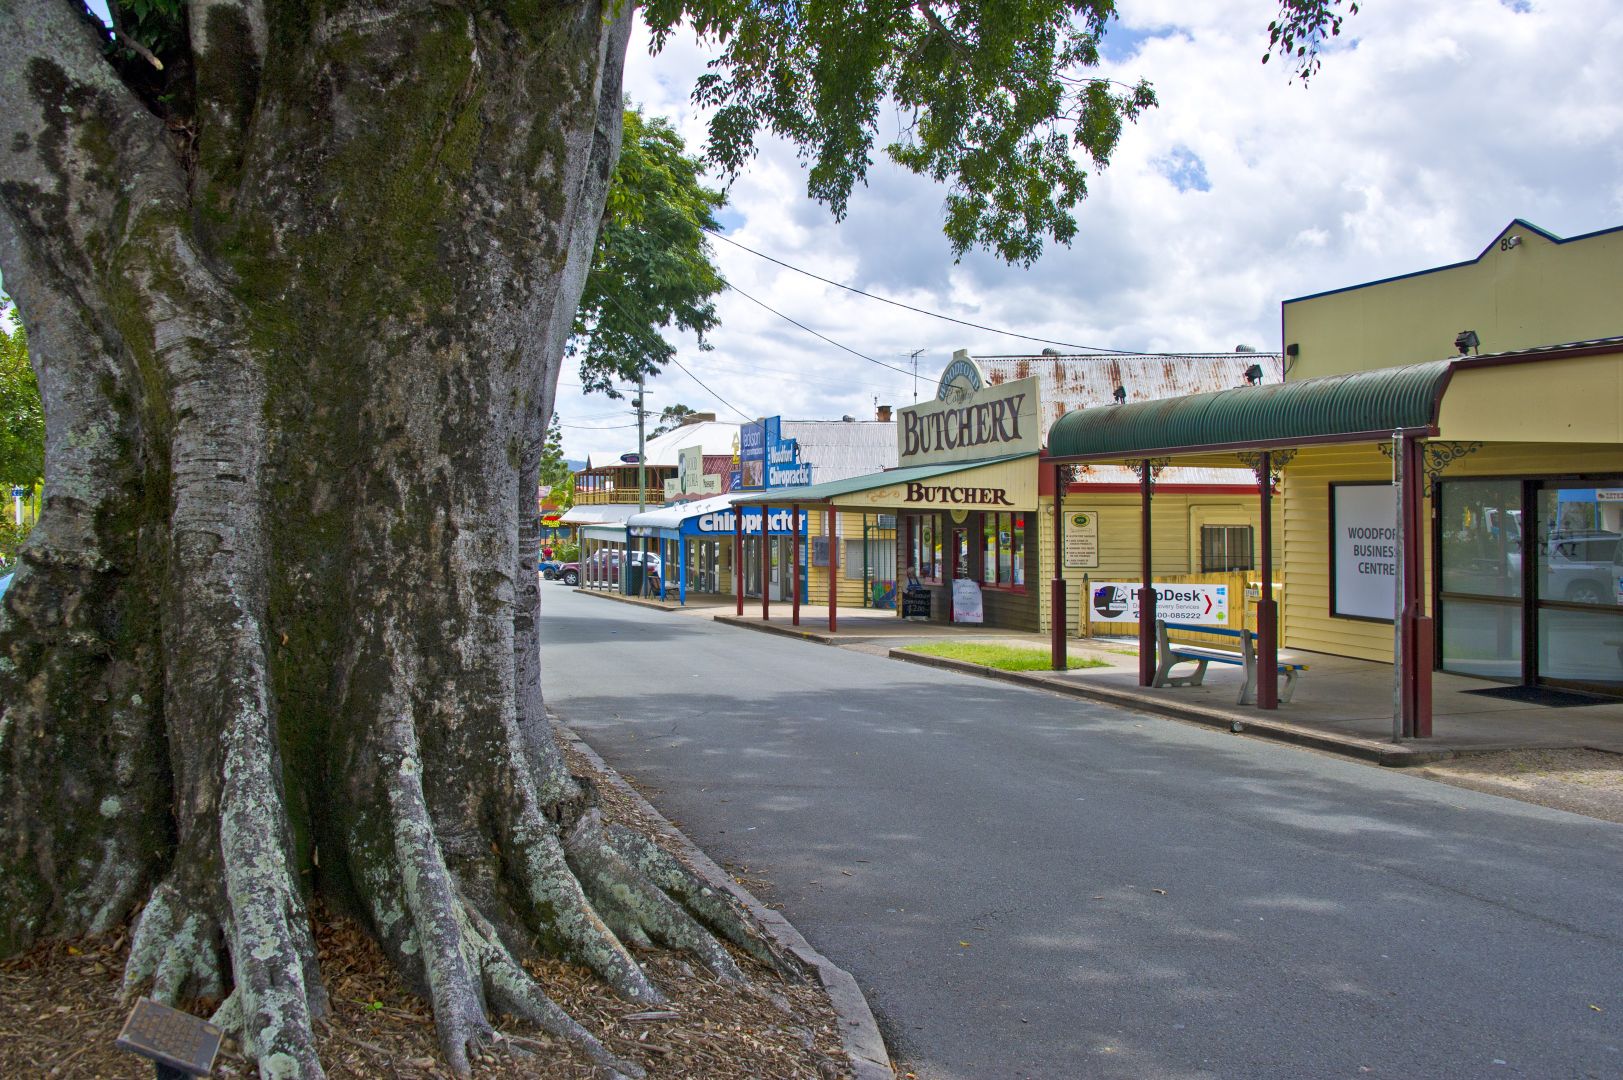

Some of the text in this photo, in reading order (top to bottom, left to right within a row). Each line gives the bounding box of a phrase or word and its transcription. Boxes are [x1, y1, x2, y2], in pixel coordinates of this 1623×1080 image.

[902, 393, 1026, 457] BUTCHERY
[769, 464, 809, 487] Chiropractic
[904, 482, 1015, 506] BUTCHER
[1353, 544, 1396, 558] BUSINES
[1358, 562, 1395, 576] CENTRE
[1131, 588, 1201, 602] HpDesk
